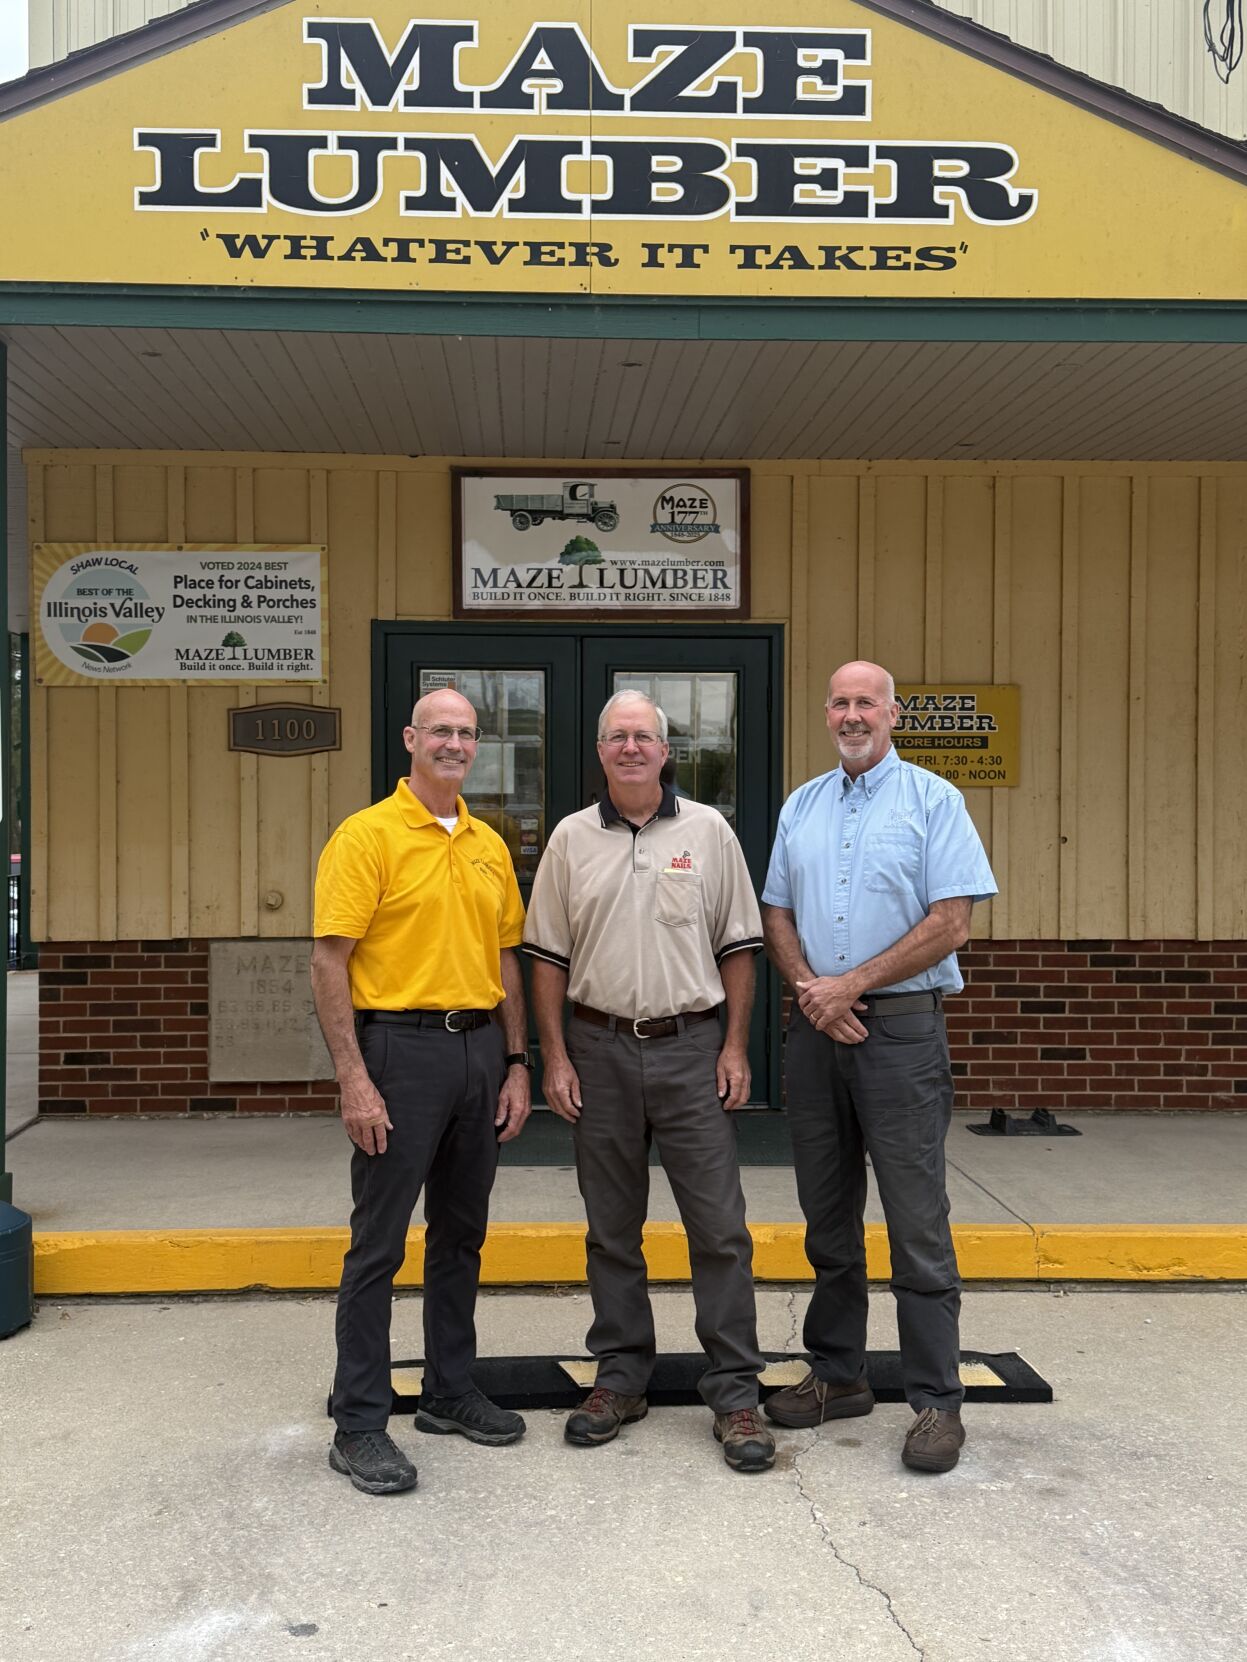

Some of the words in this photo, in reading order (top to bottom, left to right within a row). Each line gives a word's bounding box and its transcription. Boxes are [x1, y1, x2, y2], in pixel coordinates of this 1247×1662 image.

[303, 18, 872, 121] MAZE
[133, 128, 1038, 226] LUMBER
[641, 243, 709, 269] IT
[661, 495, 709, 511] MAZE
[654, 524, 717, 532] ANNIVERSARY
[69, 556, 104, 576] SHAW
[104, 556, 140, 576] LOCAL
[199, 561, 235, 571] VOTED
[236, 561, 263, 571] 2024
[264, 562, 289, 571] BEST
[609, 558, 725, 567] www.mazelumber.com
[173, 574, 215, 590] Place
[218, 574, 241, 590] for
[243, 574, 315, 592] Cabinets,
[471, 567, 565, 589] MAZE
[595, 567, 733, 590] LUMBER
[76, 588, 100, 596] BEST
[101, 588, 114, 596] OF
[115, 588, 135, 596] THE
[472, 591, 510, 601] BUILD
[513, 592, 525, 601] IT
[527, 591, 566, 601] ONCE.
[569, 592, 607, 601] BUILD
[609, 592, 621, 601] IT
[624, 592, 666, 602] RIGHT.
[669, 592, 705, 602] SINCE
[709, 592, 731, 602] 1848
[47, 601, 108, 623] Illinois
[109, 597, 165, 623] Valley
[172, 594, 237, 613] Decking
[240, 594, 253, 609] &
[257, 594, 317, 609] Porches
[186, 615, 197, 624] IN
[198, 615, 219, 624] THE
[220, 615, 262, 624] ILLINOIS
[263, 615, 303, 624] VALLEY!
[174, 648, 226, 661] MAZE
[242, 648, 316, 661] LUMBER
[81, 661, 102, 673] News
[102, 662, 132, 673] Network
[180, 662, 207, 671] Build
[209, 662, 216, 671] it
[218, 663, 245, 671] once.
[247, 662, 274, 671] Build
[276, 662, 284, 671] it
[286, 662, 313, 673] right.
[894, 694, 976, 712] MAZE
[255, 718, 316, 741] 1100
[892, 714, 997, 732] UMBER
[934, 737, 982, 747] HOURS
[668, 746, 701, 764] PEN
[917, 755, 940, 766] FRI.
[943, 755, 968, 766] 7:30
[977, 755, 1003, 766] 4:30
[968, 769, 1006, 780] NOON
[236, 954, 308, 975] MAZE
